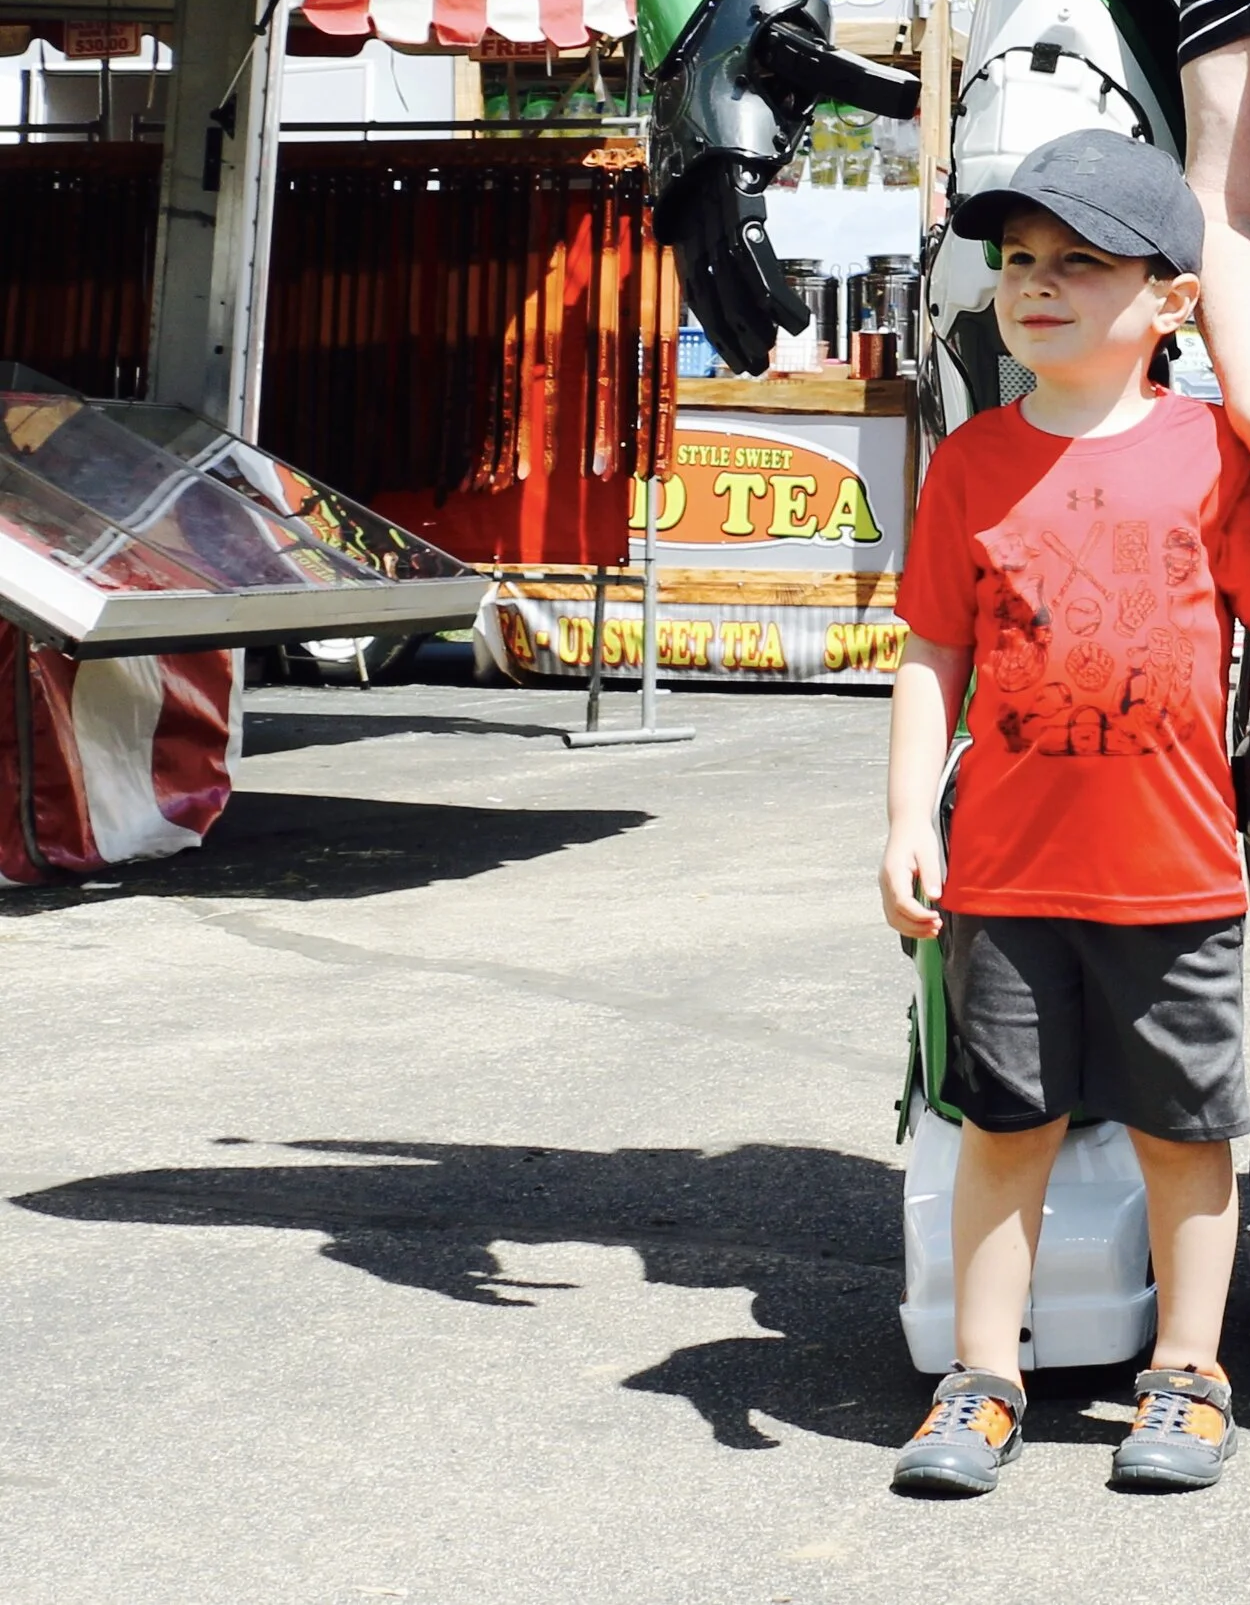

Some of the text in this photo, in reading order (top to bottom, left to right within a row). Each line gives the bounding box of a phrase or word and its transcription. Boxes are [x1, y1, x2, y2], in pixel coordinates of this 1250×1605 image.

[481, 39, 547, 57] FREE
[677, 444, 794, 470] STYLE SWEET
[713, 471, 883, 543] TEA
[719, 620, 788, 670] TEA
